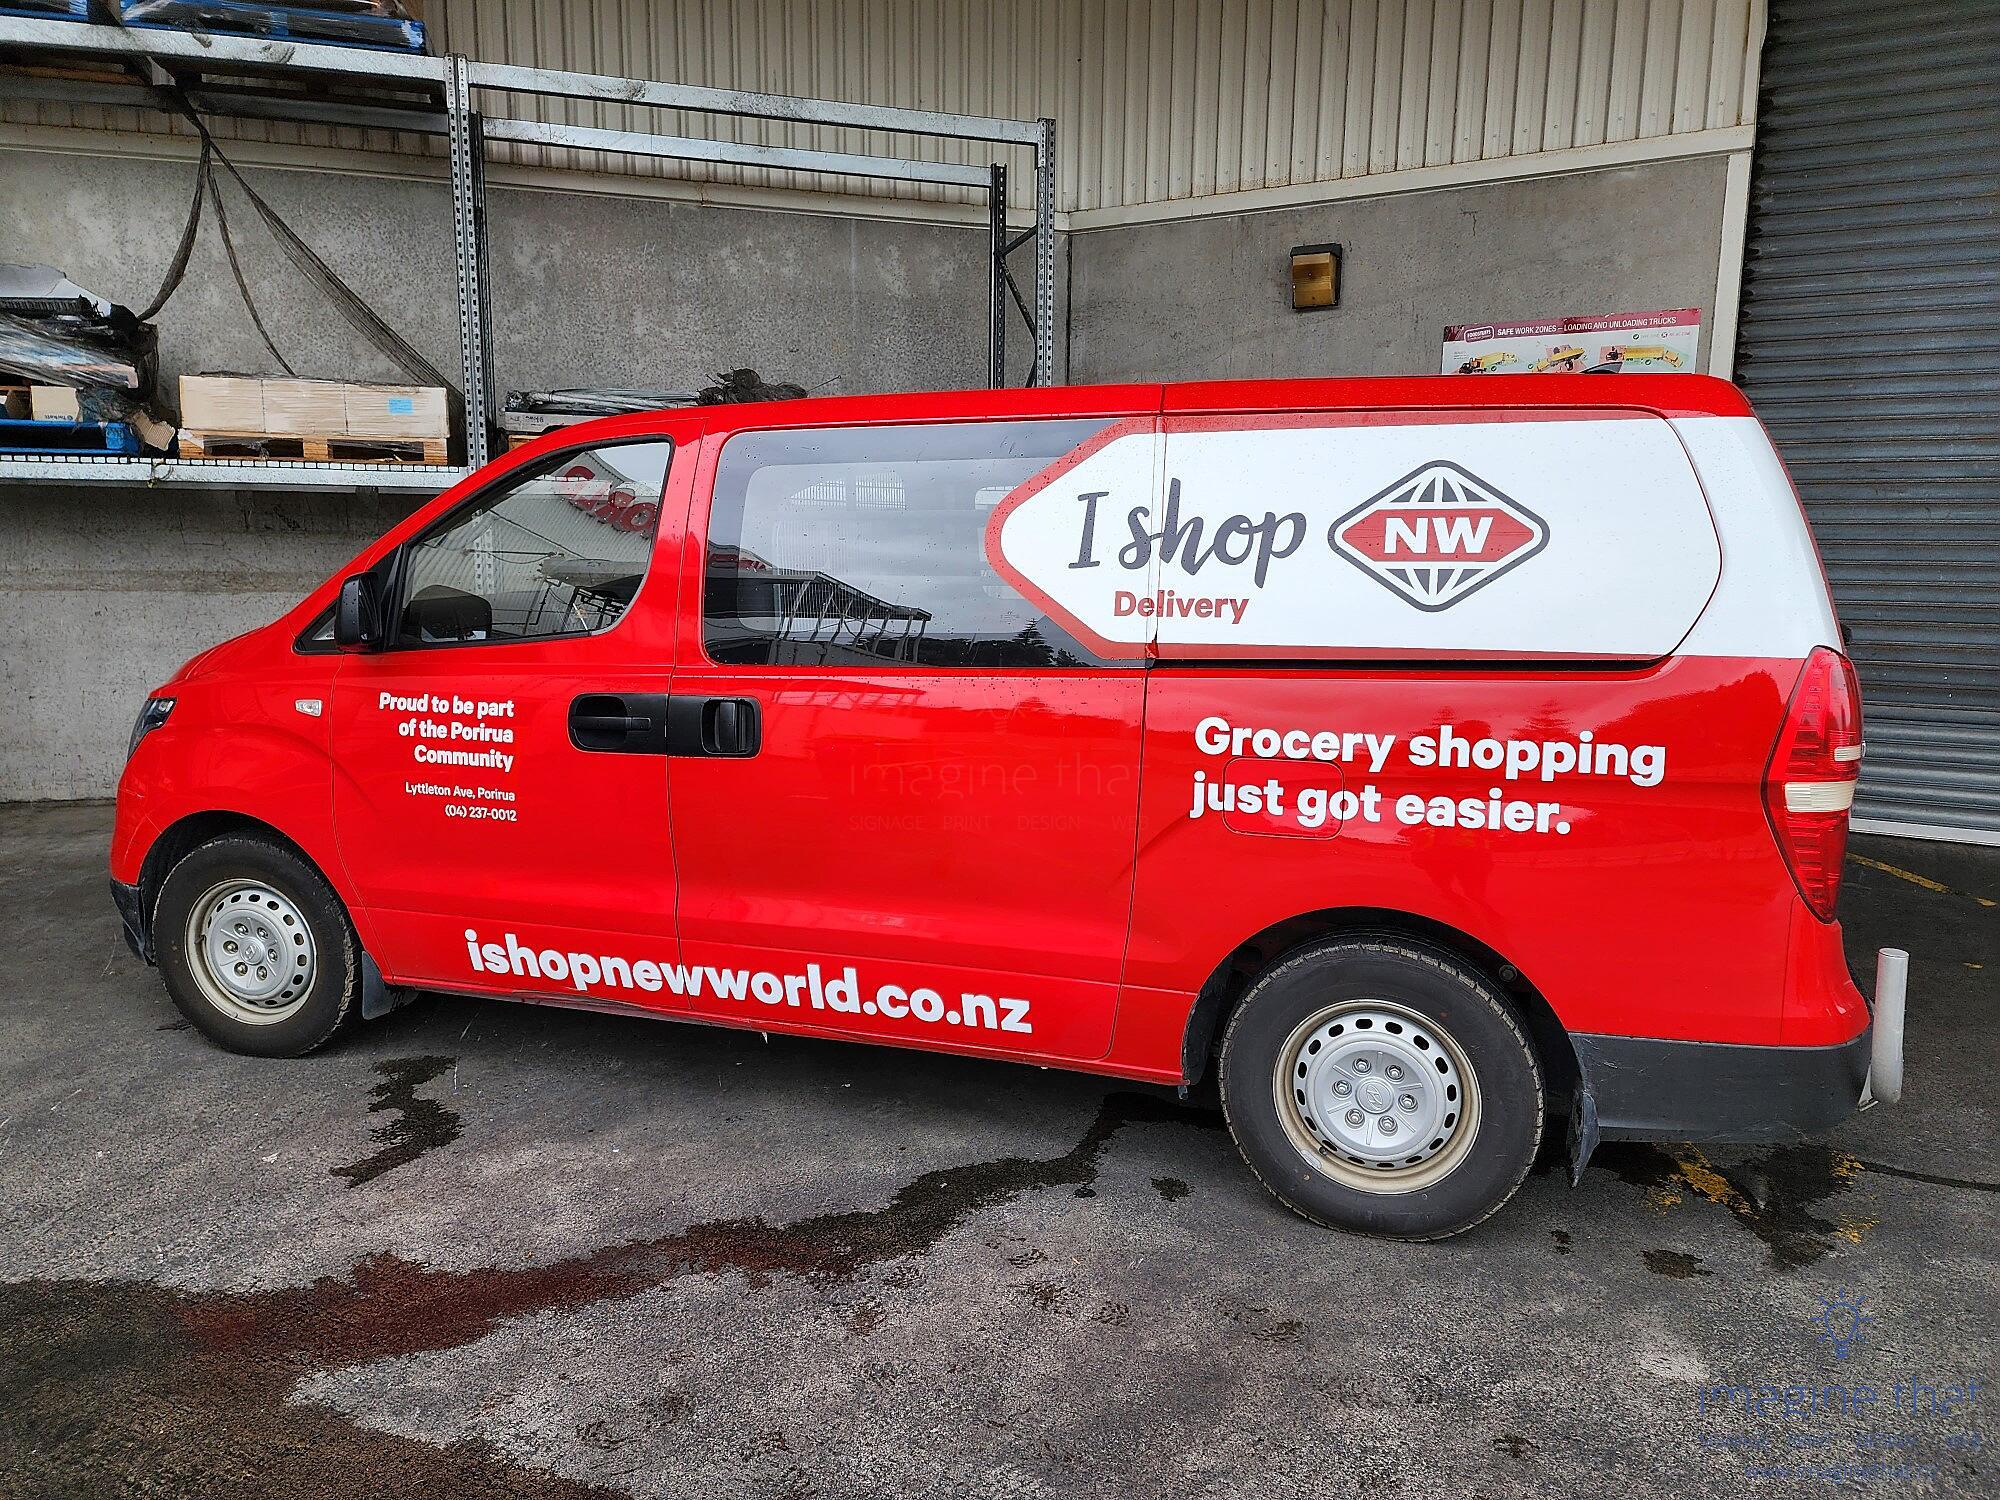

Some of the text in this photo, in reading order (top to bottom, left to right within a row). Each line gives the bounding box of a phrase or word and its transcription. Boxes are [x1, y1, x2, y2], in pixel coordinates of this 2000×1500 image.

[1497, 328, 1514, 336] SAFE
[1515, 326, 1535, 335] WORK
[1535, 325, 1557, 334] ZONES
[1563, 322, 1593, 332] LOADING
[1593, 321, 1608, 330] AND
[1609, 319, 1648, 329] UNLOADING
[1650, 316, 1677, 326] TRUCKS
[1068, 476, 1307, 589] I shop
[1383, 515, 1495, 555] NW
[1114, 590, 1250, 625] Delivery
[379, 691, 515, 720] Proud to be part
[398, 717, 514, 743] of the Porirua
[414, 744, 514, 773] Community
[1195, 717, 1667, 788] Grocery shopping
[405, 781, 516, 802] Lyttleton Ave, Porirua
[1189, 770, 1571, 835] just got easier.
[444, 804, 518, 822] (04) 237-0012
[463, 928, 1033, 1034] ishopnewworld.co.nz
